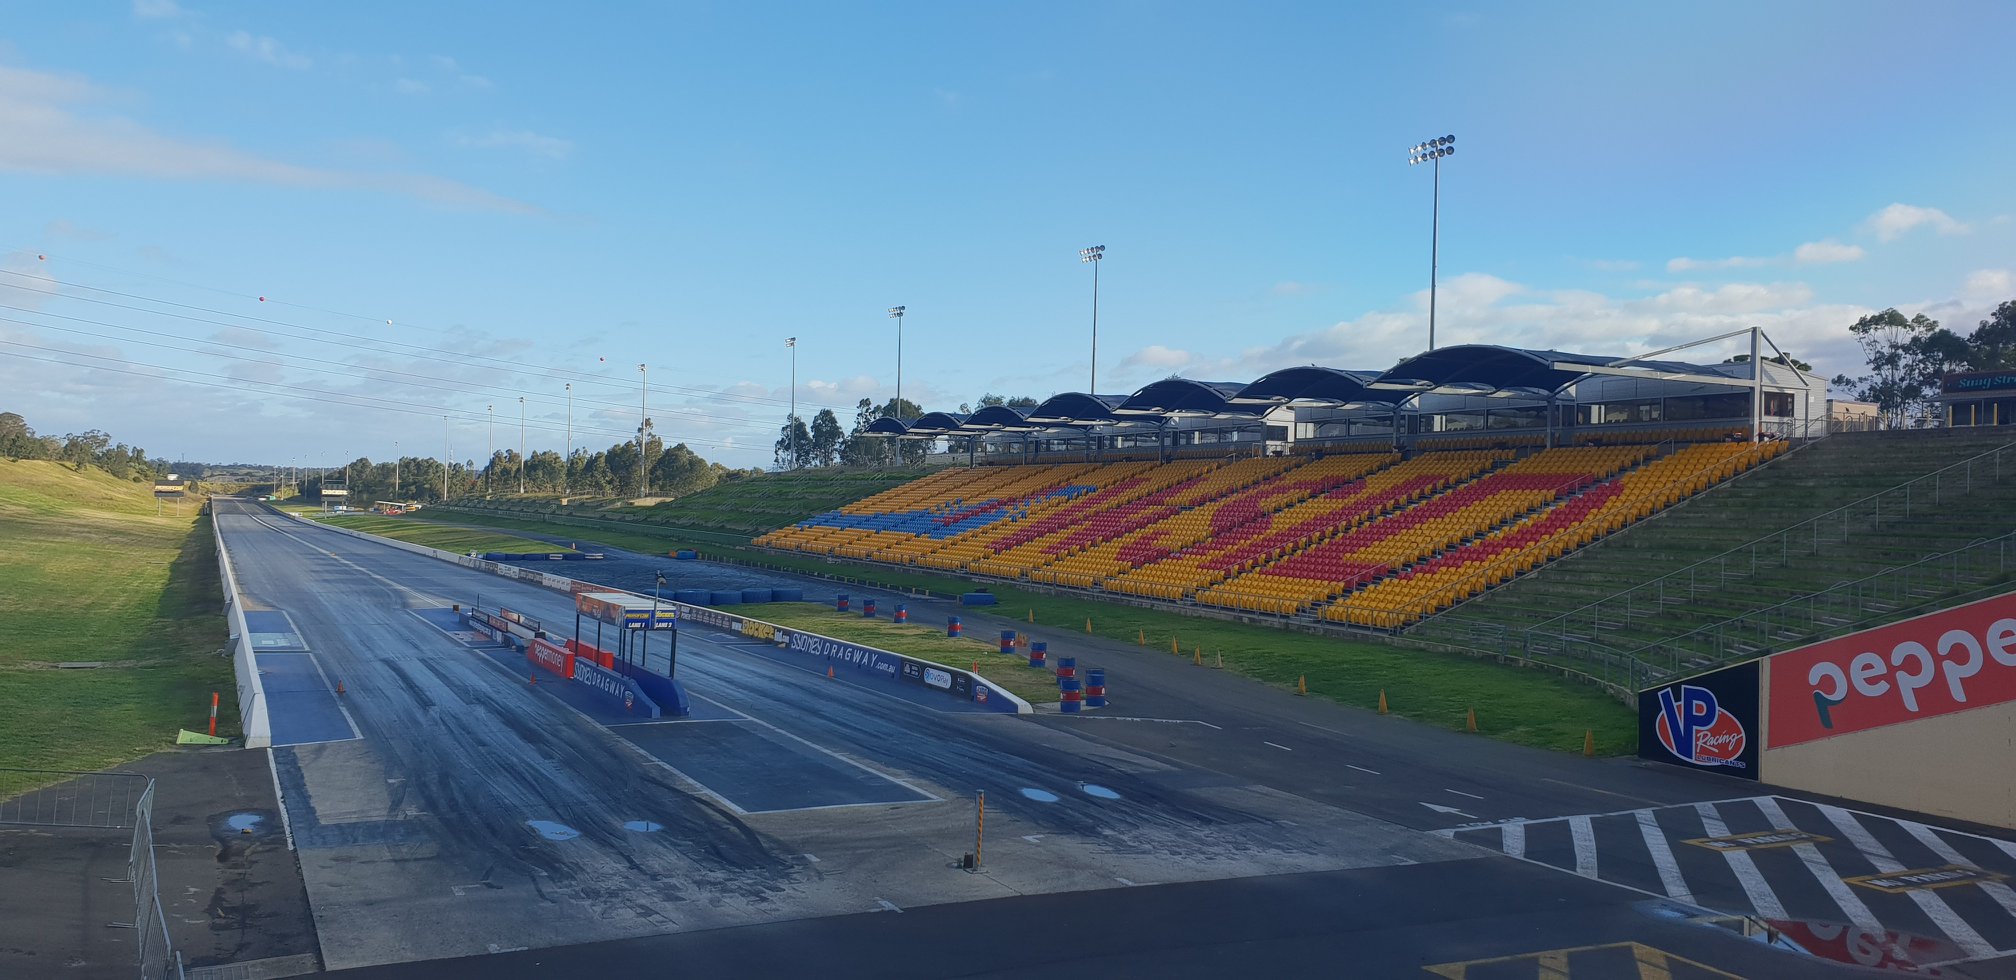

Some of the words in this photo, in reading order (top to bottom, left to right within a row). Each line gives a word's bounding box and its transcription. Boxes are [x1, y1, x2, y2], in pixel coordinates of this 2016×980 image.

[791, 633, 823, 656] SYDNEY
[823, 642, 878, 667] DRAGWAY
[592, 671, 625, 699] DRAGWAY
[1657, 684, 1719, 762] VP
[1696, 729, 1744, 753] Racing
[1696, 753, 1746, 769] LUBRICANTS
